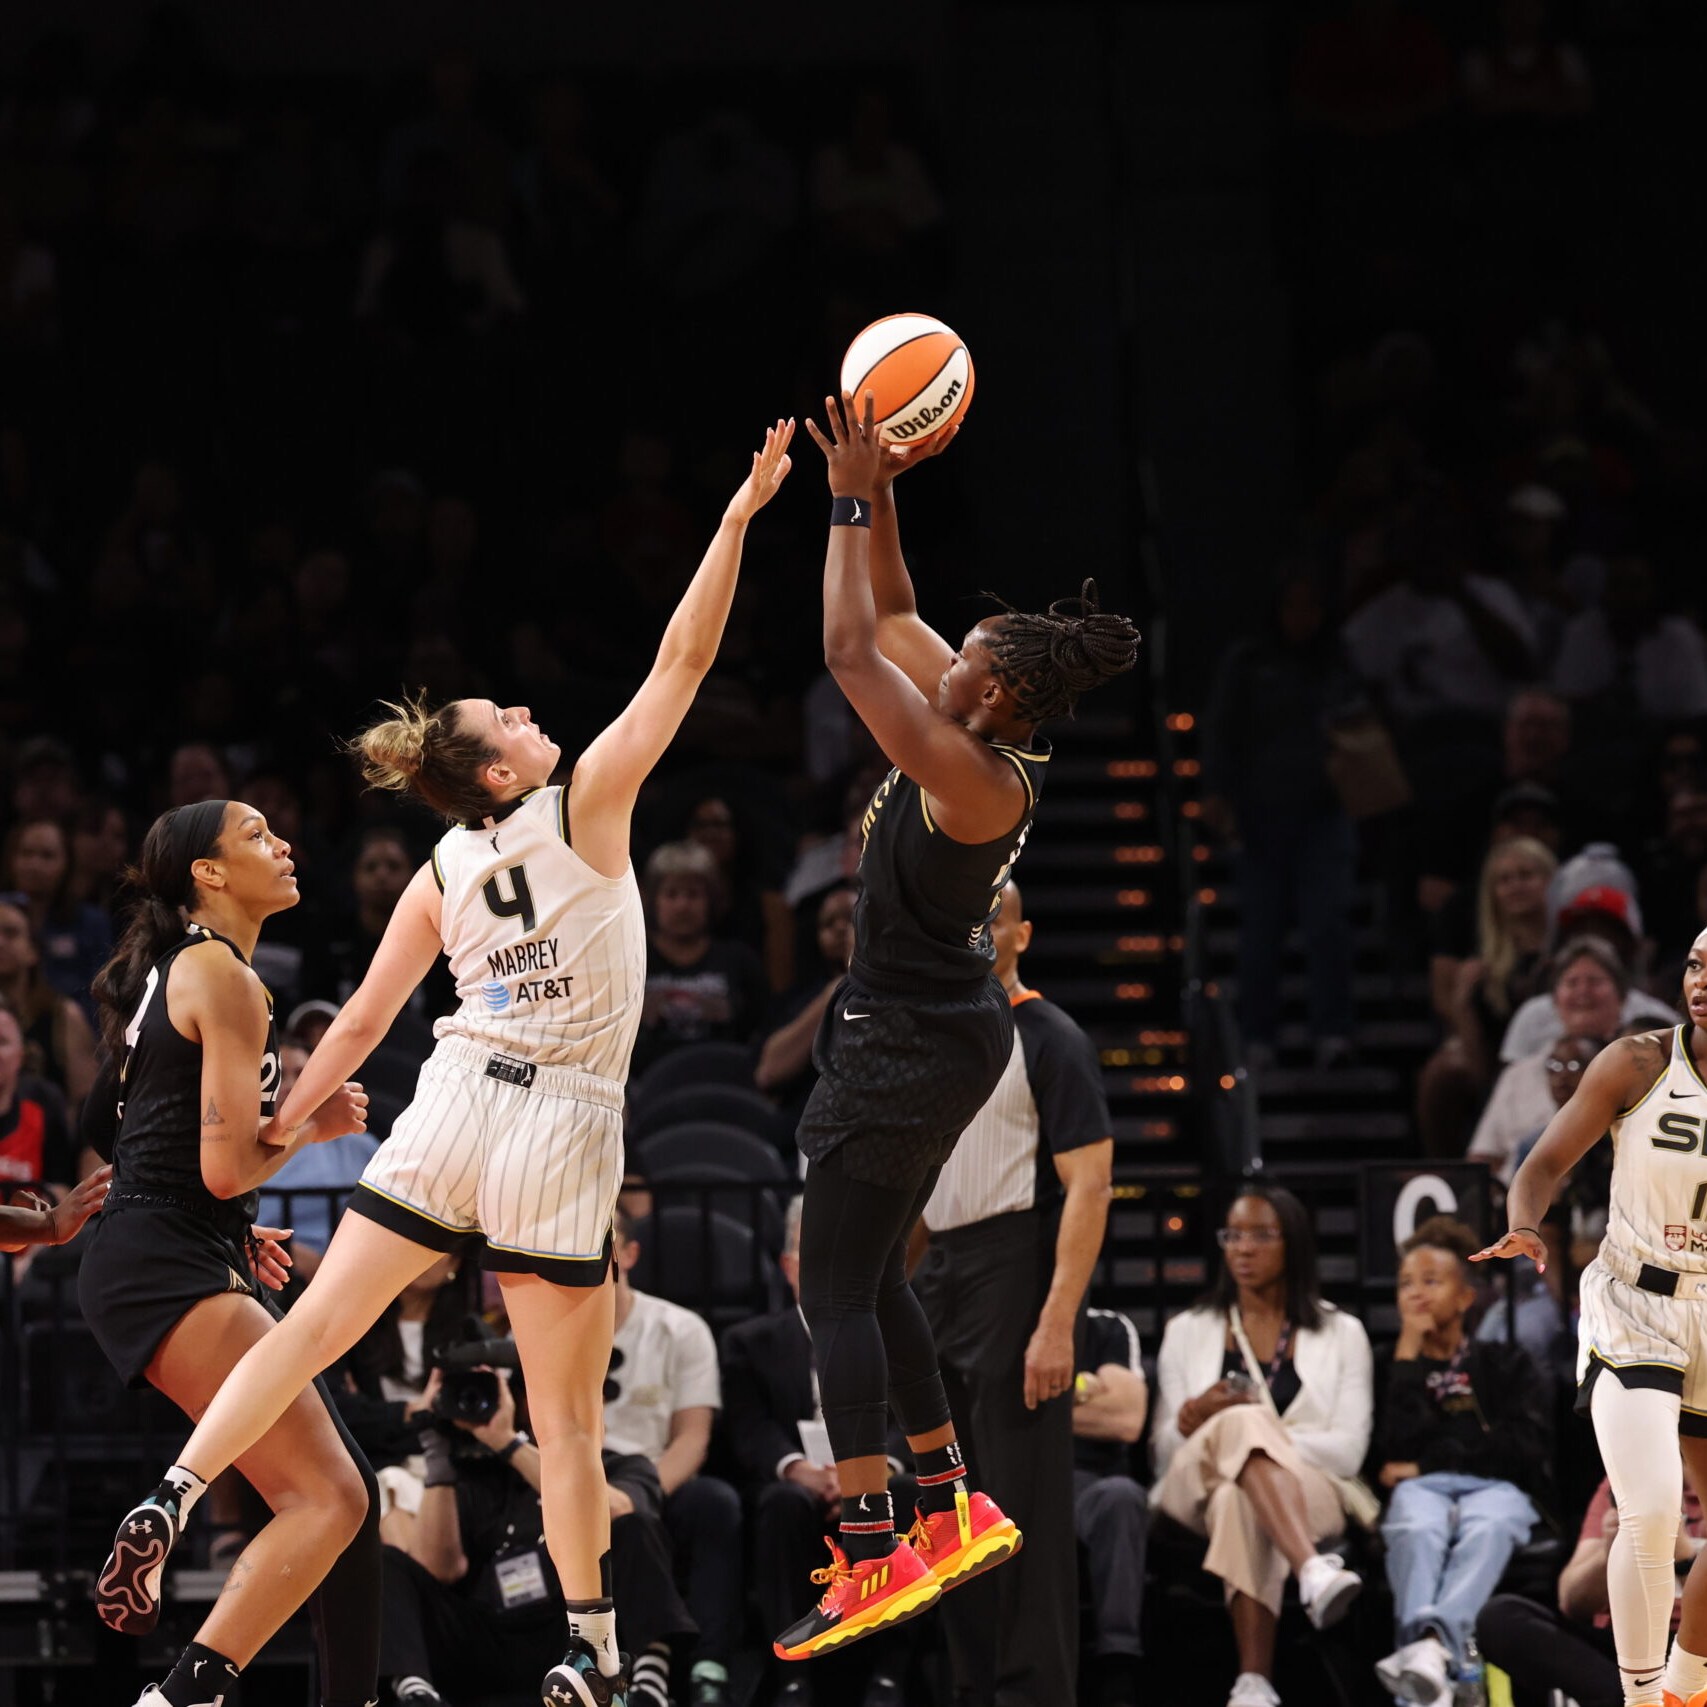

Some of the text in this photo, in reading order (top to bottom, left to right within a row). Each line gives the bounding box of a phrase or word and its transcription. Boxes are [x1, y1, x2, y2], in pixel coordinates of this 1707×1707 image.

[887, 380, 962, 439] Wilson
[480, 862, 538, 935] 4
[487, 938, 558, 978] MABREY
[516, 976, 573, 1003] AT&T
